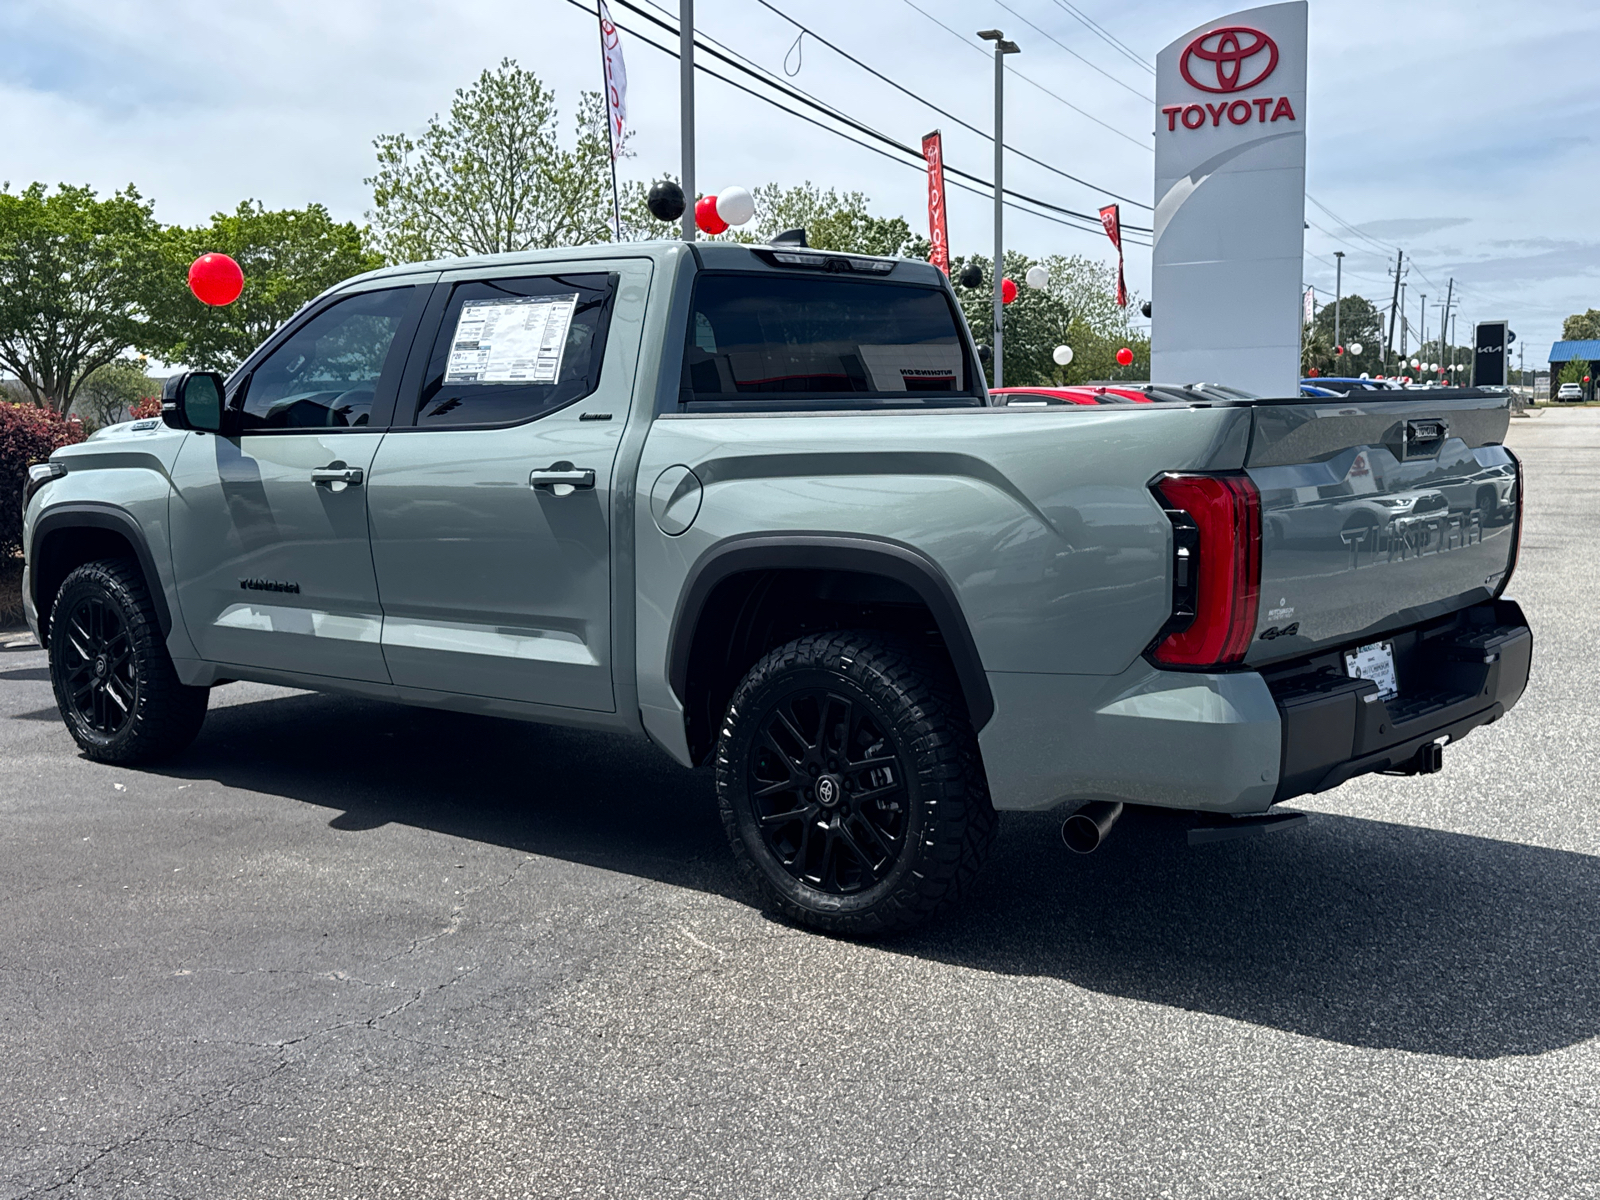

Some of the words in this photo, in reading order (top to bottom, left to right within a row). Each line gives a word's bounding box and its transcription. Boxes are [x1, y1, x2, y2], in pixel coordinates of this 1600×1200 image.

[1162, 97, 1295, 131] TOYOTA
[1339, 508, 1483, 570] TUNDRA
[239, 578, 300, 594] TUNDRA
